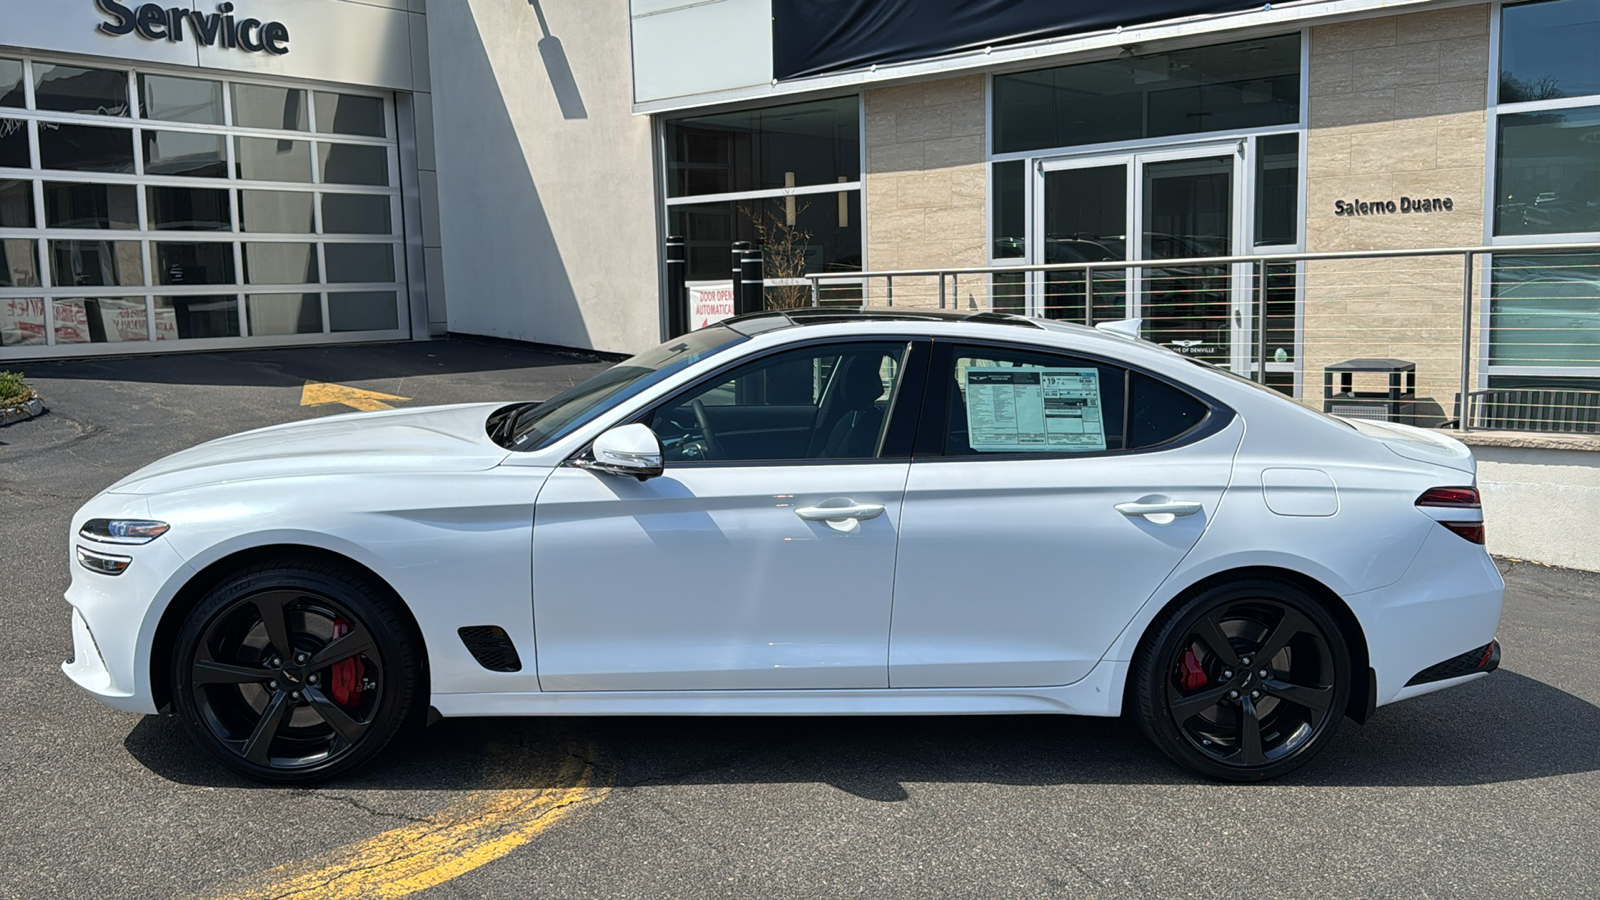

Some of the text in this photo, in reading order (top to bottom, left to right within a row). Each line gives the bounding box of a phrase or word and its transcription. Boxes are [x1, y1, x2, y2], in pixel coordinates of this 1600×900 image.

[97, 0, 290, 55] Service
[1334, 196, 1454, 216] Salerno Duane
[700, 290, 734, 301] DOOR OPEN
